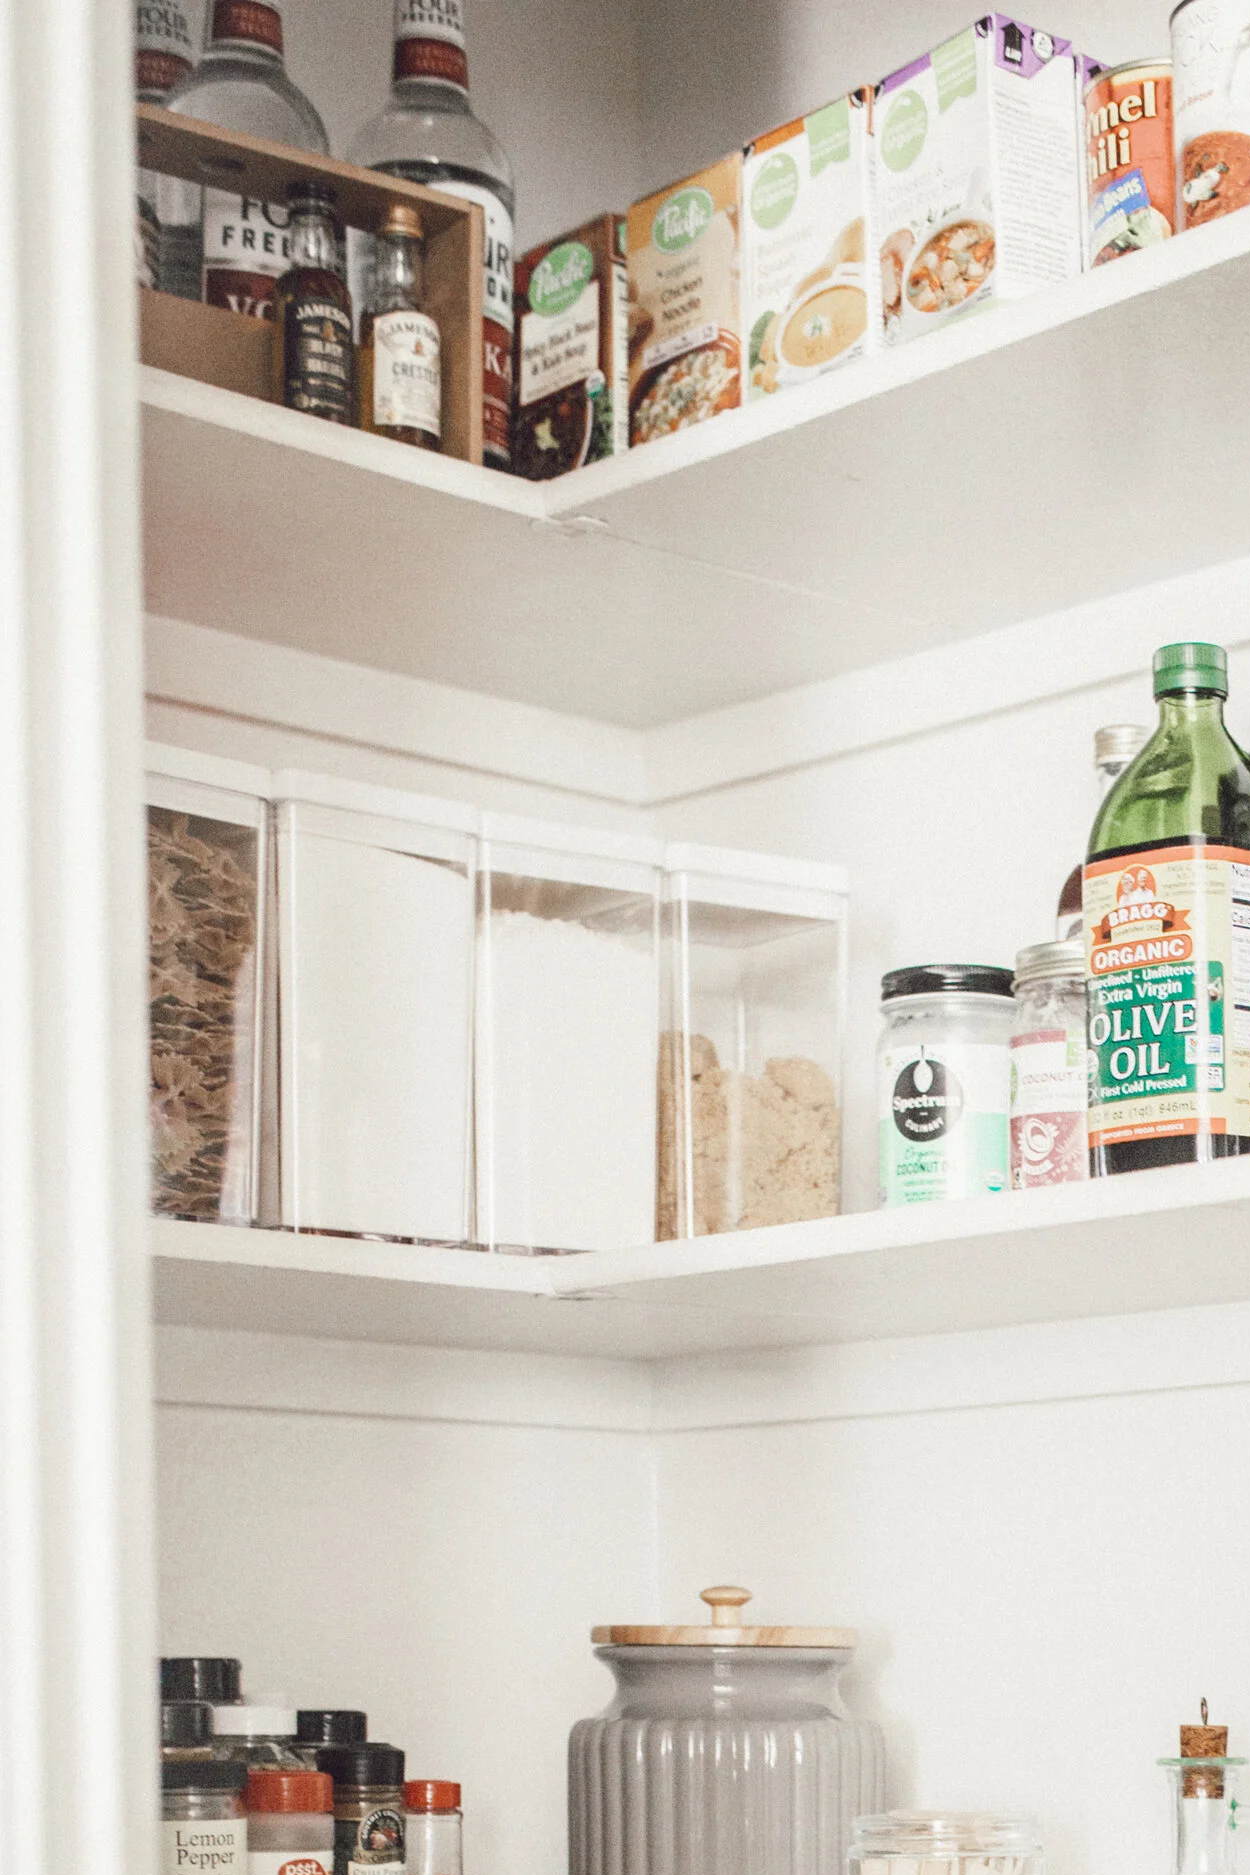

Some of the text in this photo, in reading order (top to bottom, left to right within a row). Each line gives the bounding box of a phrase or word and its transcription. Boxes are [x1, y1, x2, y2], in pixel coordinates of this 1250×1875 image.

[1088, 80, 1157, 137] mel
[1108, 902, 1169, 928] BRAGG
[1094, 938, 1185, 970] ORGANIC
[1098, 980, 1183, 1006] Extra Virgin
[1089, 998, 1199, 1047] OLIVE
[1109, 1041, 1171, 1082] OIL
[1100, 1074, 1188, 1099] First Cold Pressed
[176, 1830, 235, 1847] Lemon
[177, 1848, 235, 1870] Pepper
